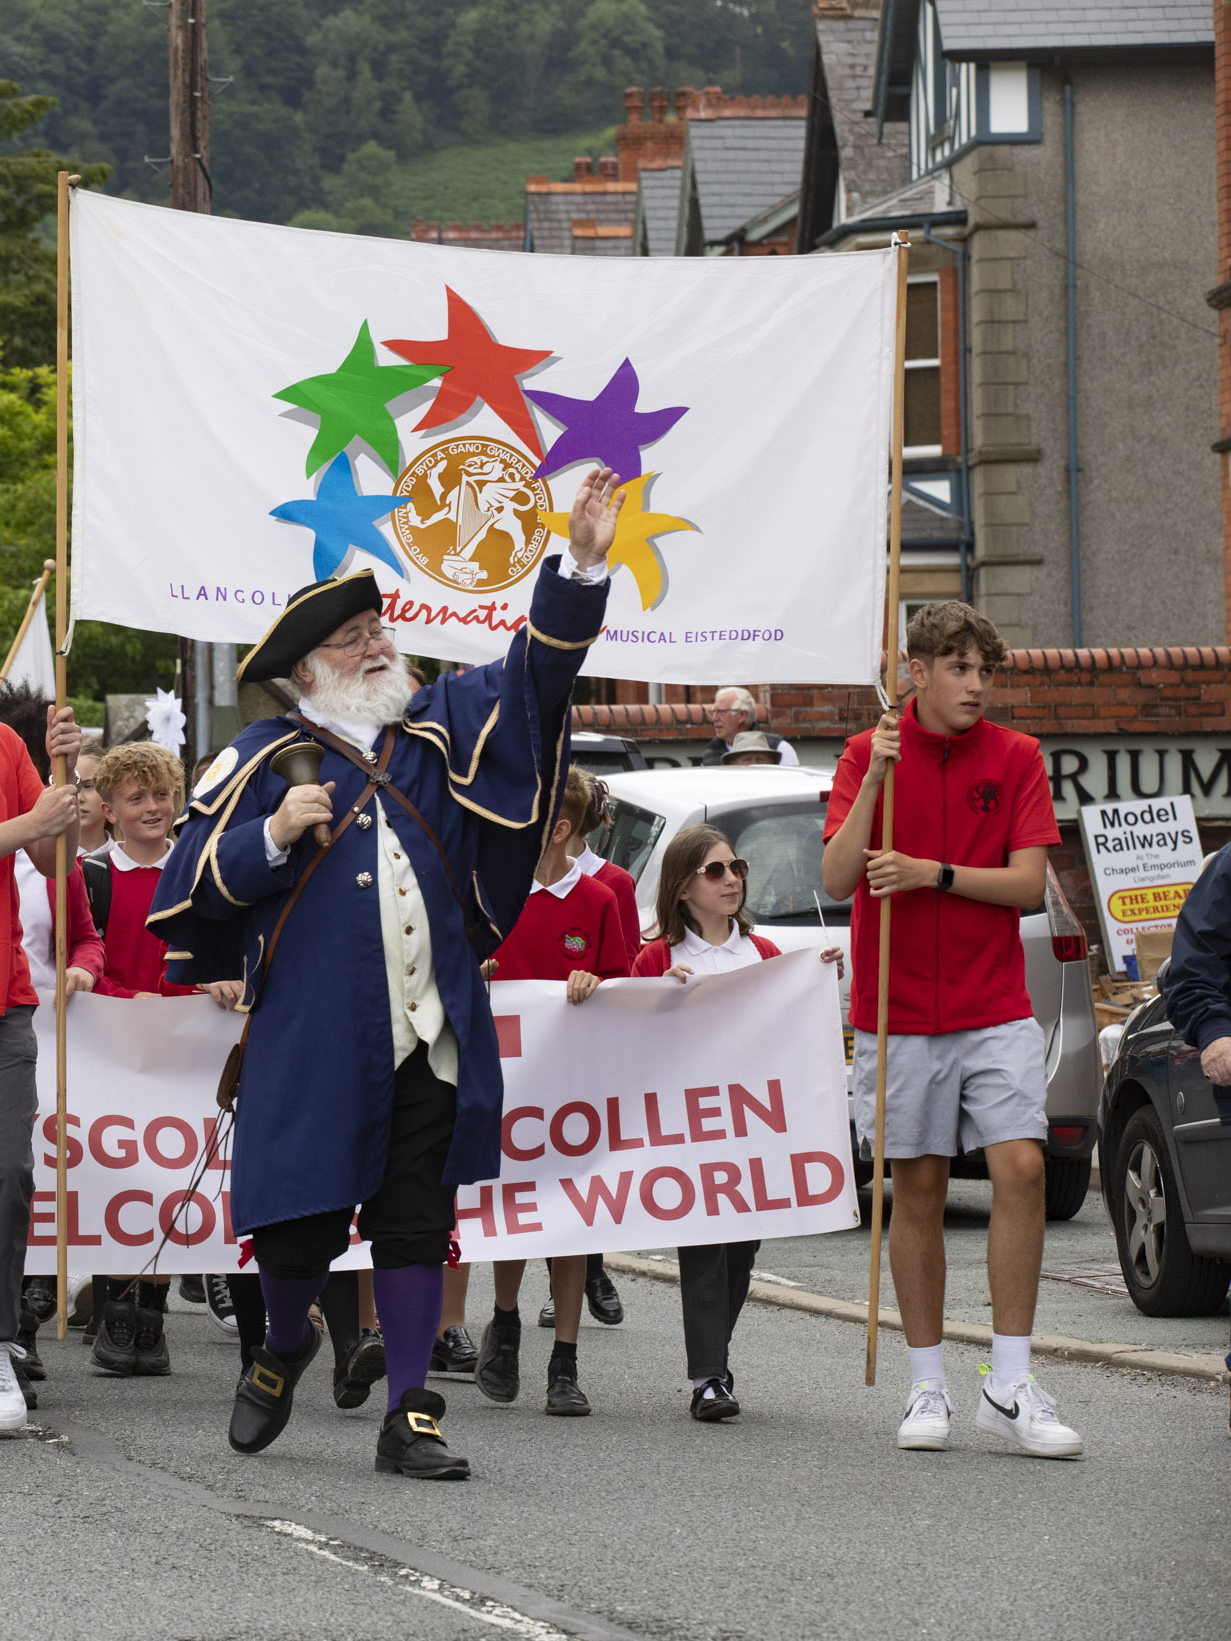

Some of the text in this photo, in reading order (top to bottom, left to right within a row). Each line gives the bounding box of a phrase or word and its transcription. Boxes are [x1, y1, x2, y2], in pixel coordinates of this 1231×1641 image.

[436, 450, 447, 462] A
[448, 443, 483, 455] GANO
[414, 457, 435, 477] BYD
[400, 476, 417, 498] YDD
[530, 482, 546, 511] FYDD
[398, 508, 414, 543] GWYN
[409, 544, 430, 565] BYD
[521, 528, 544, 564] GERDDI
[507, 562, 522, 576] FO
[605, 629, 677, 644] MUSICAL
[684, 628, 785, 643] EISTEDDFOD
[1100, 801, 1178, 830] Model
[1094, 828, 1194, 855] Railways
[1145, 852, 1160, 861] The
[1103, 859, 1196, 876] Chapel Emporium
[1133, 872, 1171, 884] Llangollen
[1118, 892, 1149, 907] THE
[31, 1078, 788, 1170] SGOL COLLEN
[558, 1150, 846, 1228] WORLD
